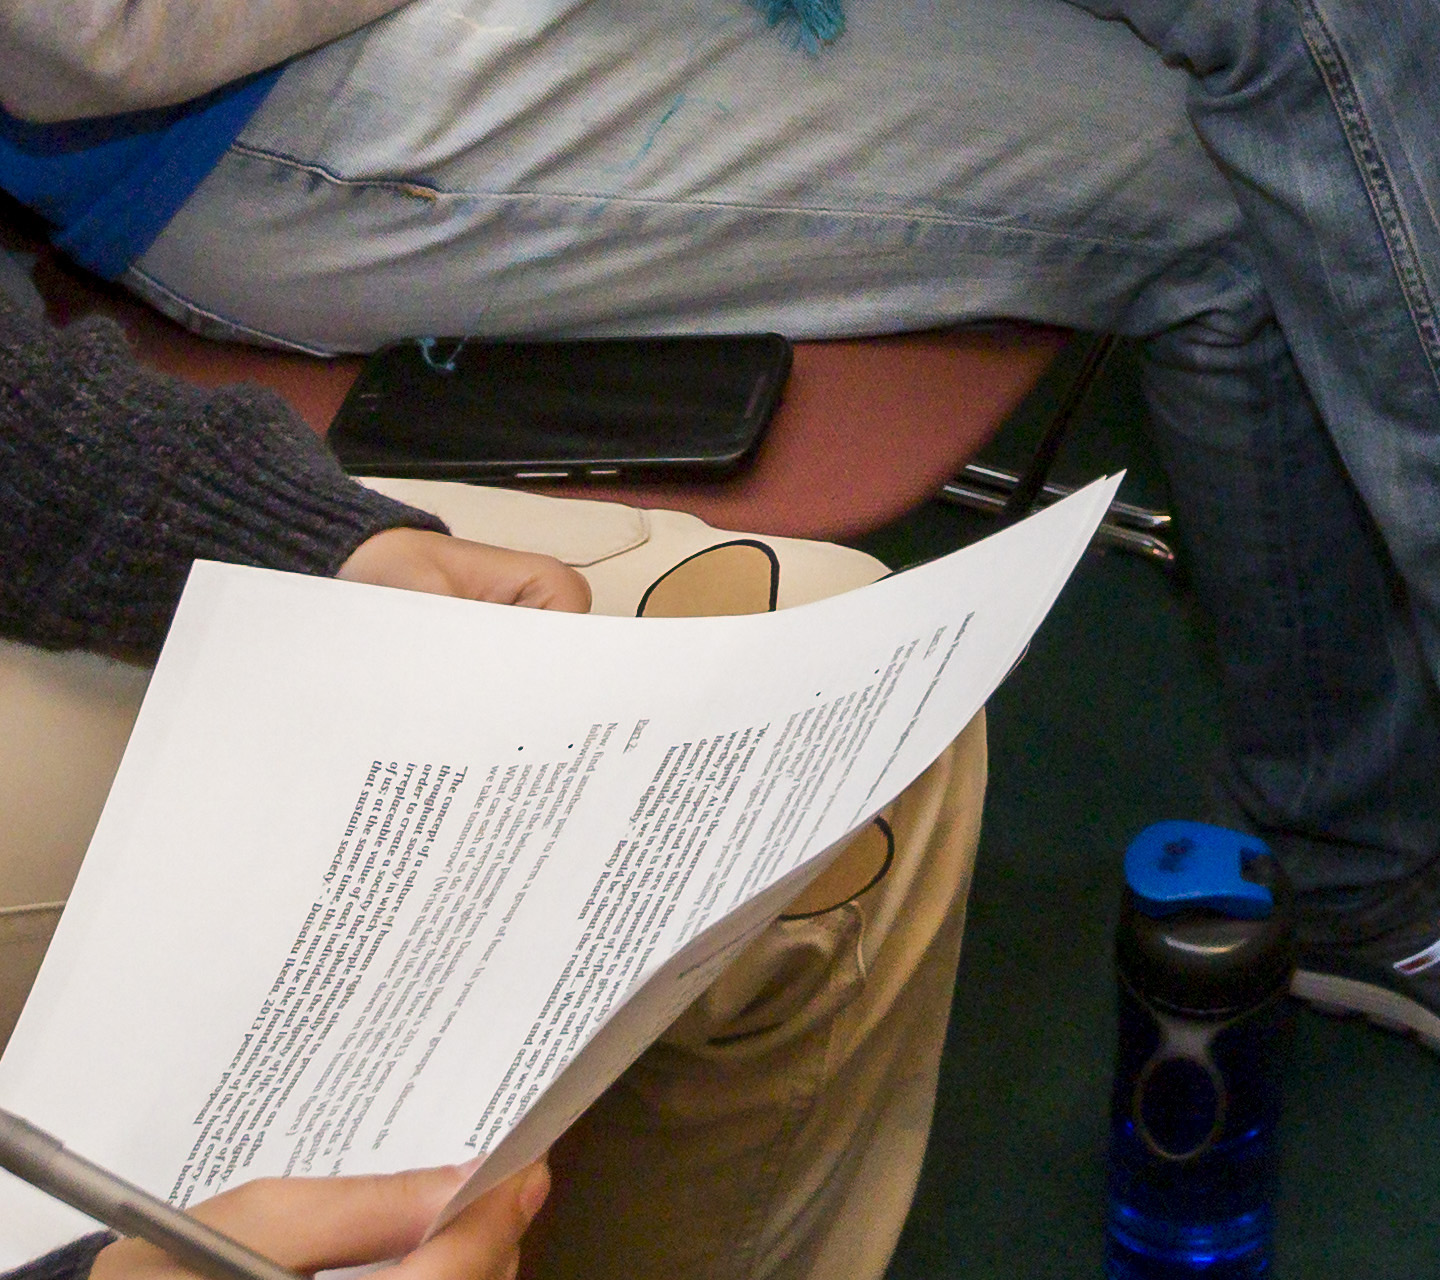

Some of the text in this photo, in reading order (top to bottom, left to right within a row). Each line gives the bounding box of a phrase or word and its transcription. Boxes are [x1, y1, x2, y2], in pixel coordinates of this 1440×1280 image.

[363, 759, 382, 787] that
[385, 760, 398, 776] of
[412, 763, 432, 800] order
[343, 789, 369, 837] sustain
[371, 797, 384, 812] at
[373, 761, 418, 848] irreplaceable
[405, 801, 418, 815] to
[412, 764, 451, 835] throughout
[361, 814, 378, 836] the
[424, 795, 452, 843] concept
[386, 816, 410, 857] create
[416, 844, 430, 858] of
[345, 836, 367, 872] same
[356, 849, 379, 884] value
[381, 858, 391, 867] a
[391, 836, 418, 879] society
[413, 858, 423, 868] a
[347, 885, 362, 900] of
[358, 869, 386, 912] society
[384, 881, 399, 893] in
[390, 869, 418, 913] culture
[289, 901, 323, 954] Daisaku
[317, 907, 336, 931] this
[333, 900, 354, 930] each
[344, 913, 365, 940] that
[364, 895, 390, 932] which
[380, 914, 395, 928] of
[299, 933, 322, 966] must
[299, 932, 341, 995] individual
[341, 934, 369, 975] people
[358, 929, 390, 971] human
[291, 967, 308, 984] be
[317, 942, 350, 991] upholds
[278, 985, 297, 1006] the
[305, 993, 323, 1013] the
[308, 977, 346, 1032] mutually
[335, 973, 363, 1010] rights
[280, 997, 305, 1028] must
[316, 1011, 340, 1041] aims
[228, 1032, 254, 1069] peace
[238, 1007, 285, 1076] foundation
[266, 1030, 288, 1053] live
[278, 1014, 310, 1057] dignity
[308, 1042, 322, 1055] to
[257, 1054, 273, 1067] in
[267, 1059, 282, 1073] of
[275, 1032, 314, 1084] treasure
[227, 1077, 242, 1091] of
[244, 1069, 263, 1089] the
[273, 1056, 312, 1109] promote
[192, 1071, 232, 1125] proposal
[214, 1092, 234, 1112] the
[220, 1090, 250, 1125] heart
[245, 1086, 281, 1131] human
[246, 1097, 257, 1106] a
[209, 1126, 224, 1142] of
[223, 1108, 250, 1144] sense
[262, 1110, 277, 1128] an
[185, 1114, 221, 1161] human
[213, 1146, 228, 1162] of
[241, 1129, 266, 1167] ethos
[190, 1142, 215, 1182] every
[203, 1163, 222, 1187] the
